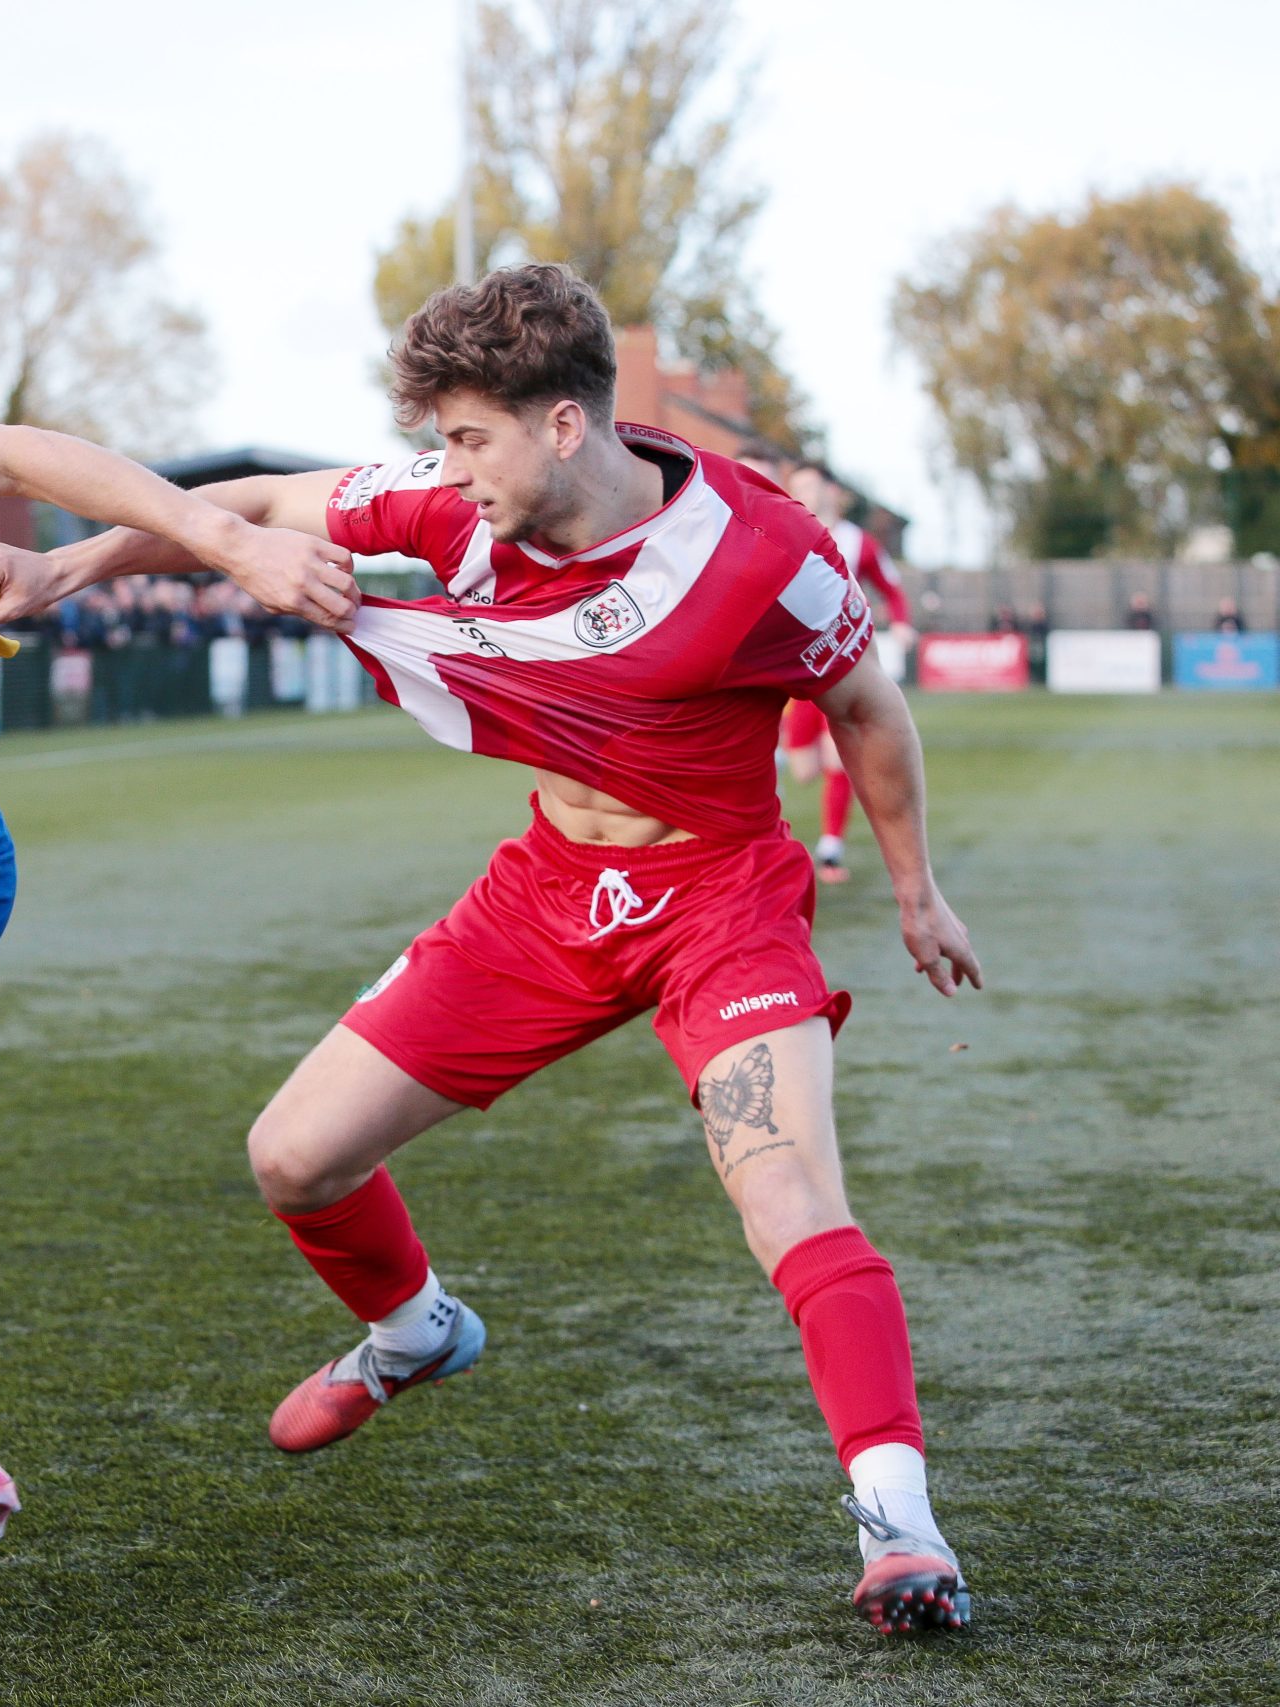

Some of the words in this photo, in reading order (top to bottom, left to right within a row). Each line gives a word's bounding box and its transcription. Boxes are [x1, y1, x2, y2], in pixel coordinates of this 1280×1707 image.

[630, 426, 674, 444] ROBINS
[807, 618, 842, 660] PITCHING
[825, 633, 840, 653] IN
[719, 991, 800, 1021] uhlsport
